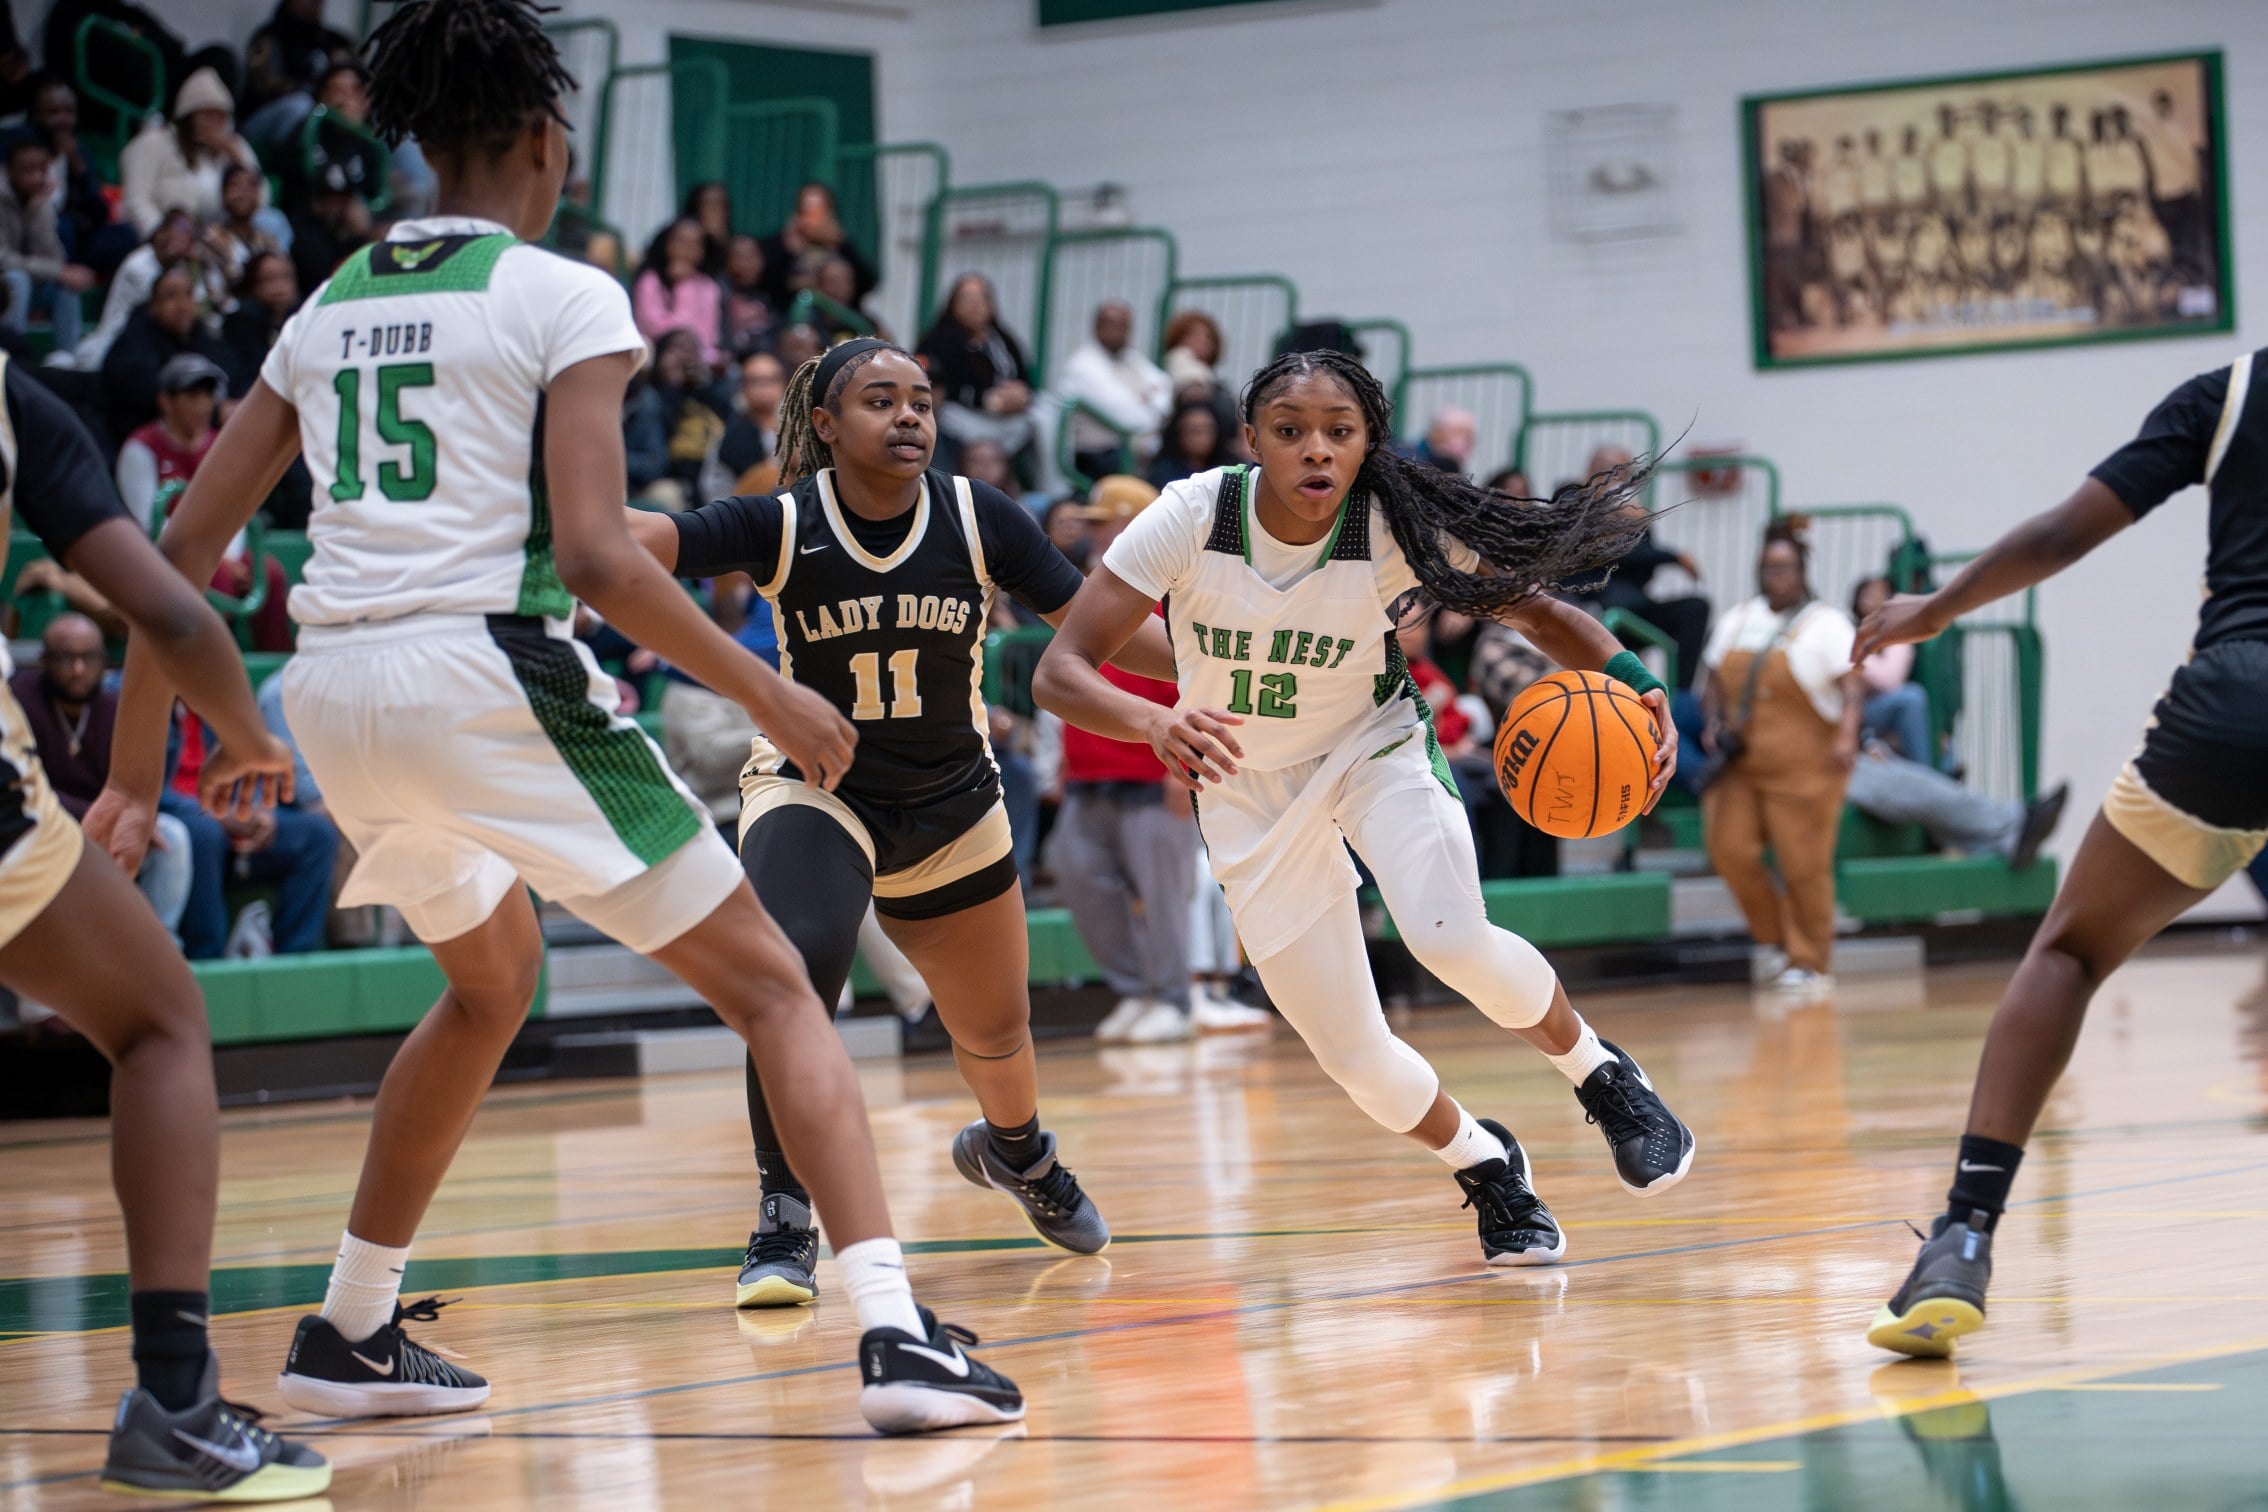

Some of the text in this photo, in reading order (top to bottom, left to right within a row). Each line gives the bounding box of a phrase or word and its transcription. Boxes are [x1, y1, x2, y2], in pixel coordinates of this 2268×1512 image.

[342, 322, 433, 360] T-DUBB
[329, 362, 437, 503] 15
[795, 594, 971, 643] LADY DOGS
[1192, 621, 1356, 669] THE NEST
[849, 649, 923, 721] 11
[1227, 669, 1298, 719] 12
